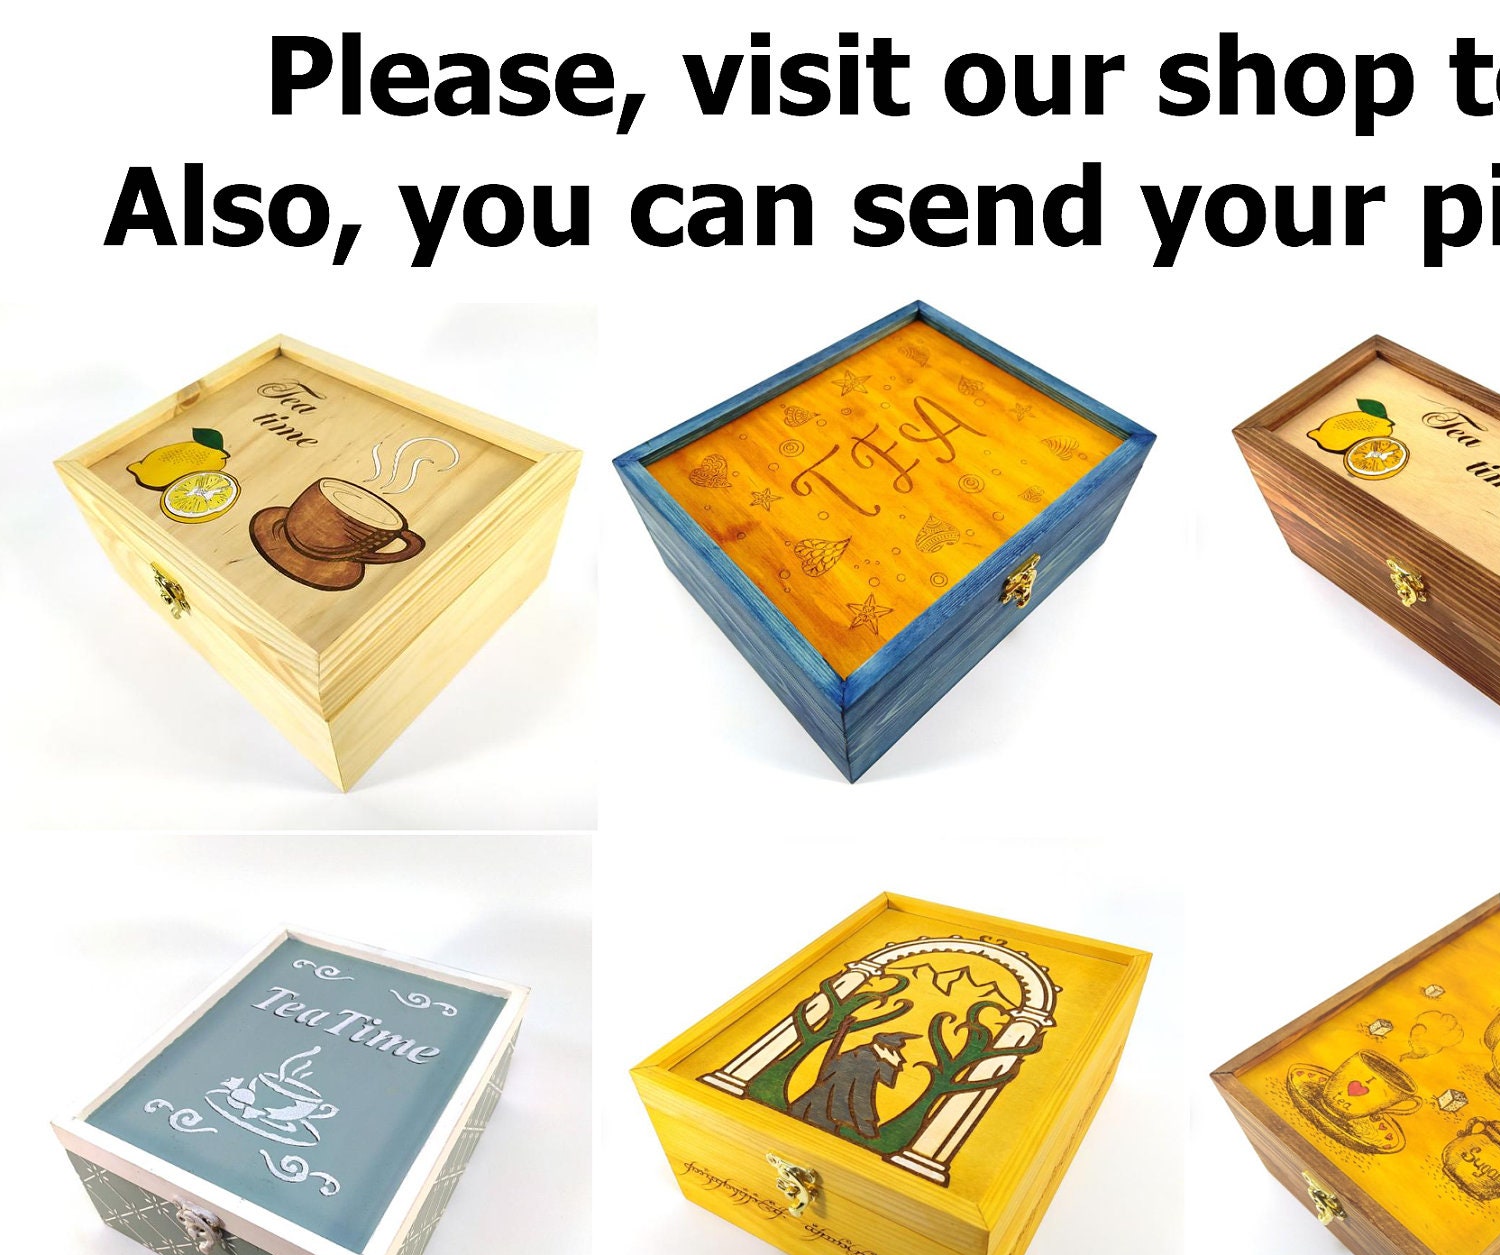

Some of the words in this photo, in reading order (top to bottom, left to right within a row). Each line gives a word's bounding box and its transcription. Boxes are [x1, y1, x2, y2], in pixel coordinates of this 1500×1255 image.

[257, 378, 327, 415] Tea
[253, 413, 318, 448] time
[1422, 407, 1488, 448] Tea
[791, 395, 987, 517] TEA
[251, 986, 331, 1027] Tea
[323, 1009, 440, 1064] Time
